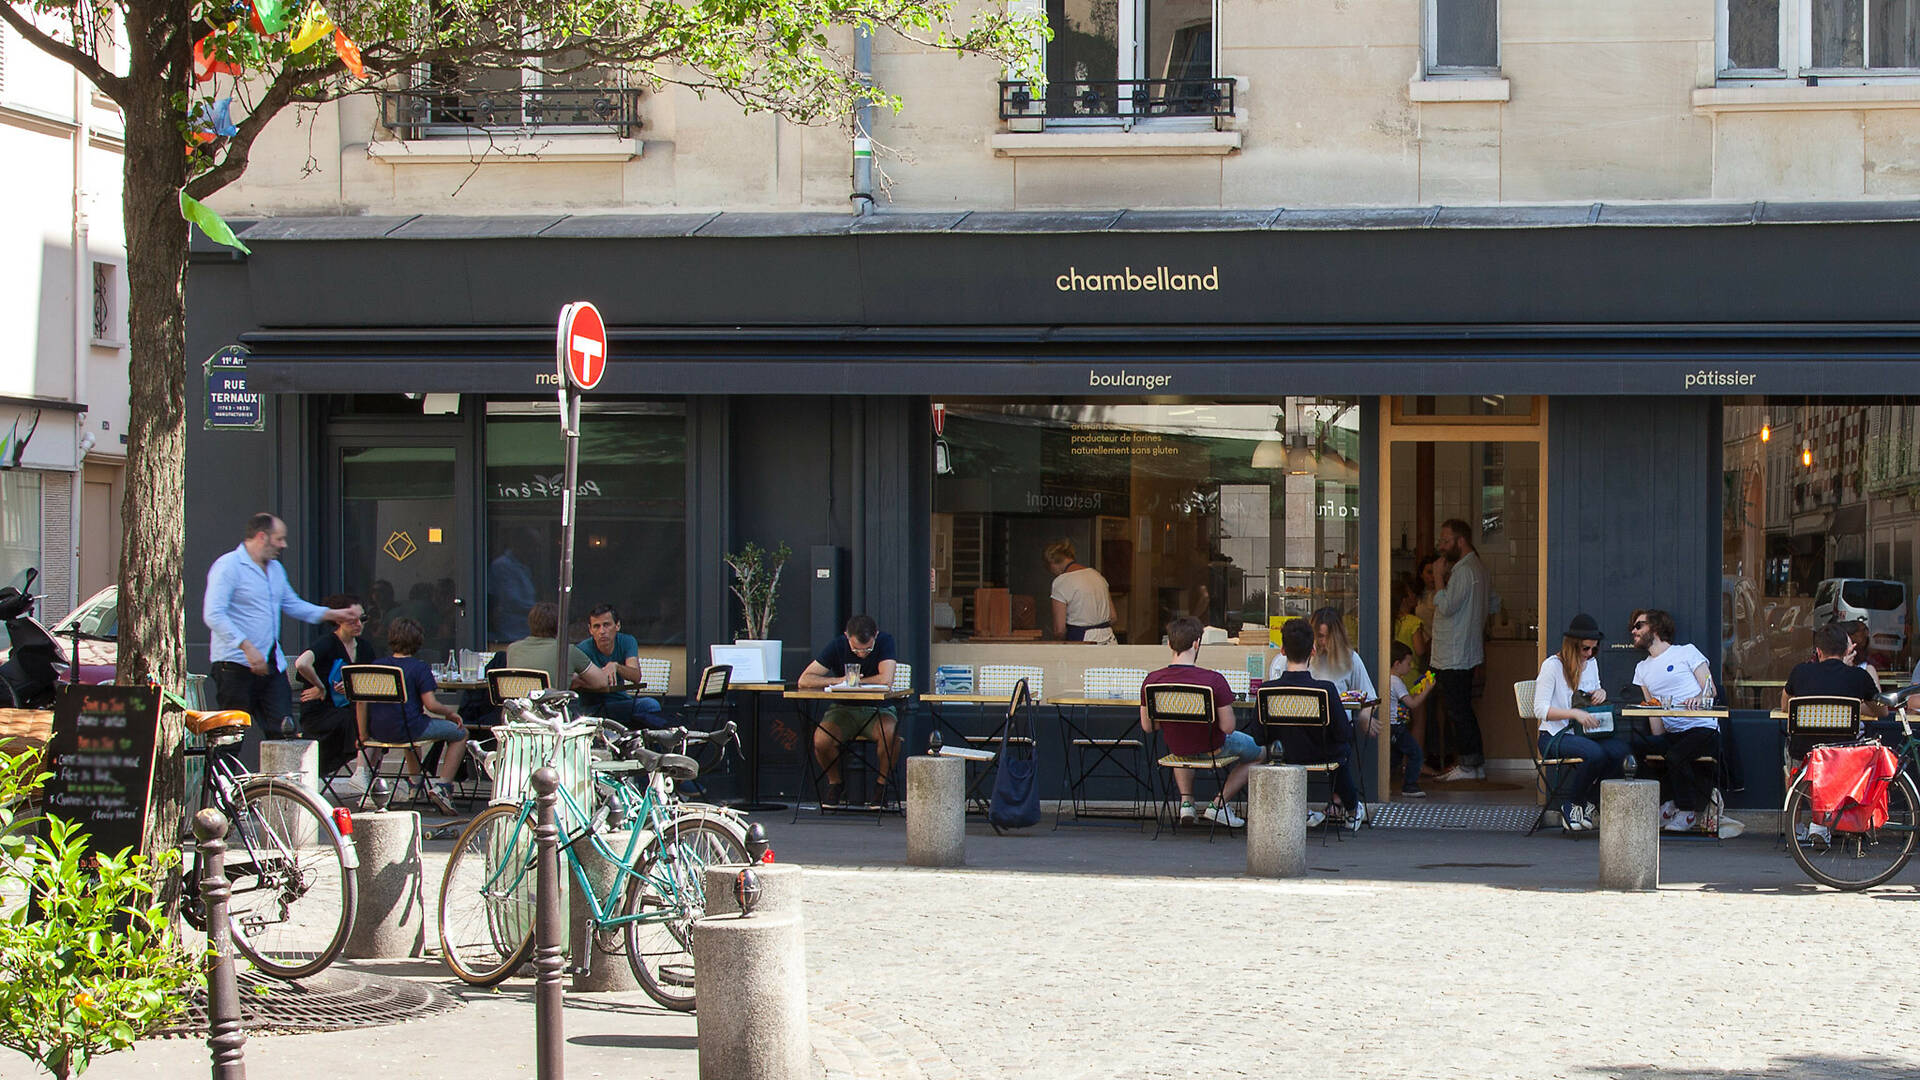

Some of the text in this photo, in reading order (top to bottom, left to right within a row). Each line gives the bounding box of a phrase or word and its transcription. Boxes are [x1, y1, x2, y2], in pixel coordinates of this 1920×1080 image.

[1056, 265, 1219, 291] chambelland
[224, 379, 246, 390] RUE
[1089, 369, 1172, 390] boulanger
[1685, 369, 1757, 390] pâtissier
[211, 393, 258, 403] TERNAUX
[1071, 433, 1162, 443] producteur de farines
[1071, 445, 1179, 456] naturellement sans gluten
